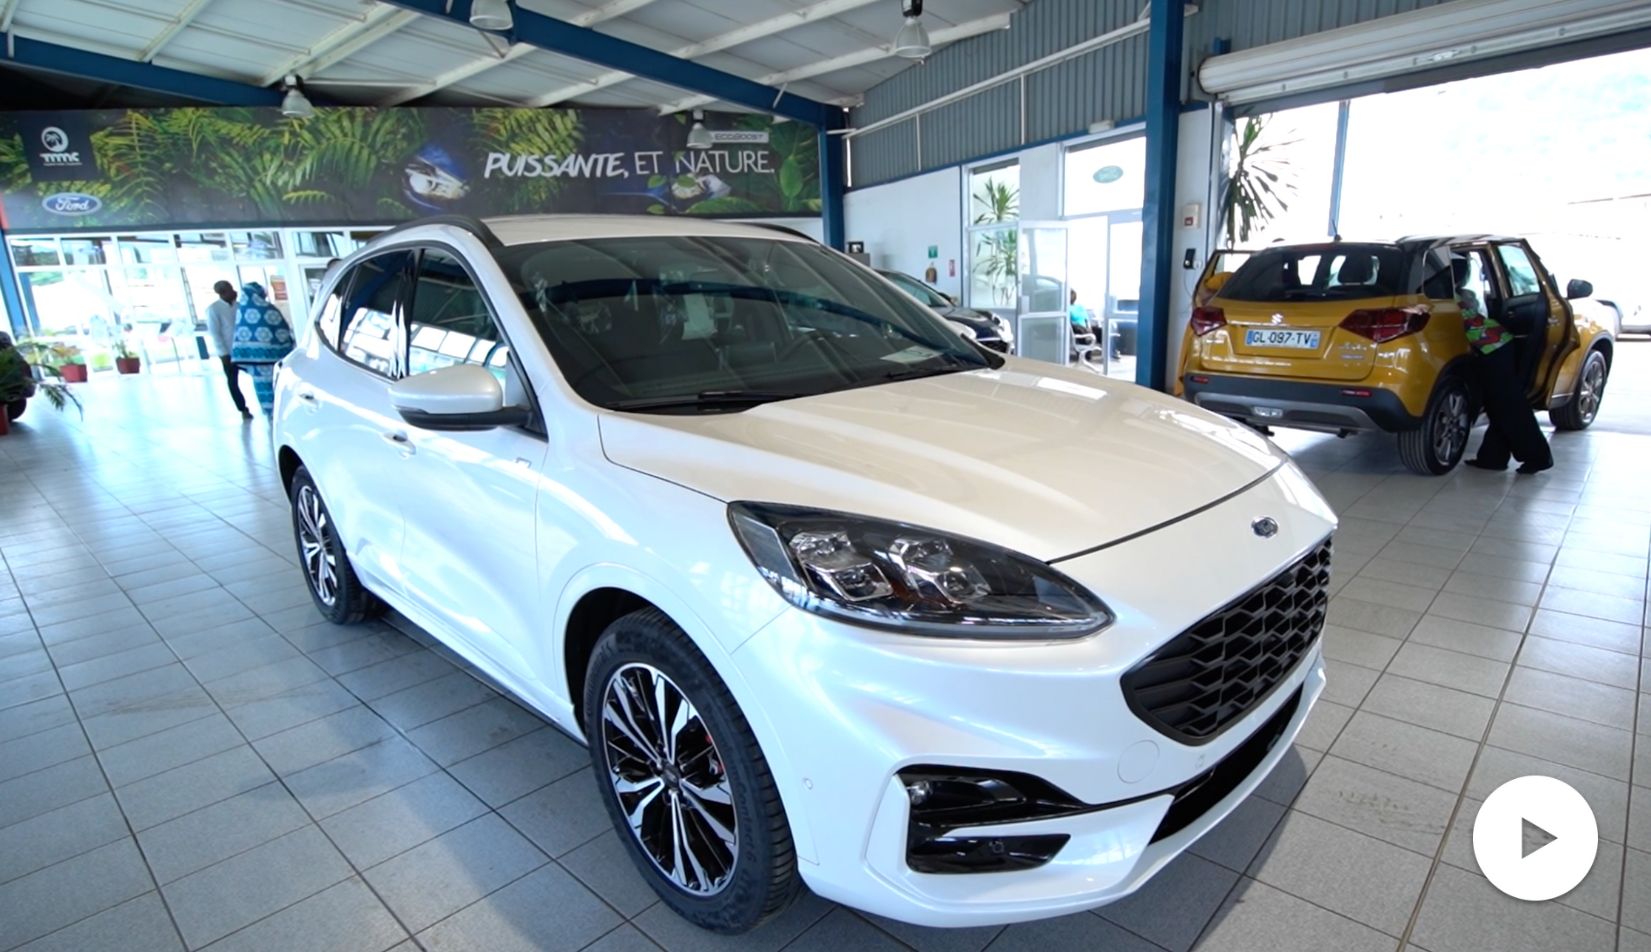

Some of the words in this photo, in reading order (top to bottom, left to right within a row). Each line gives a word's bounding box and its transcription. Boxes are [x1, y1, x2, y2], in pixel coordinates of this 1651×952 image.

[715, 133, 764, 141] ECOBOOST
[484, 152, 629, 179] PUISSANTE,
[634, 151, 663, 175] ET
[675, 150, 775, 174] NATURE.
[1252, 331, 1312, 345] GL-097-TV
